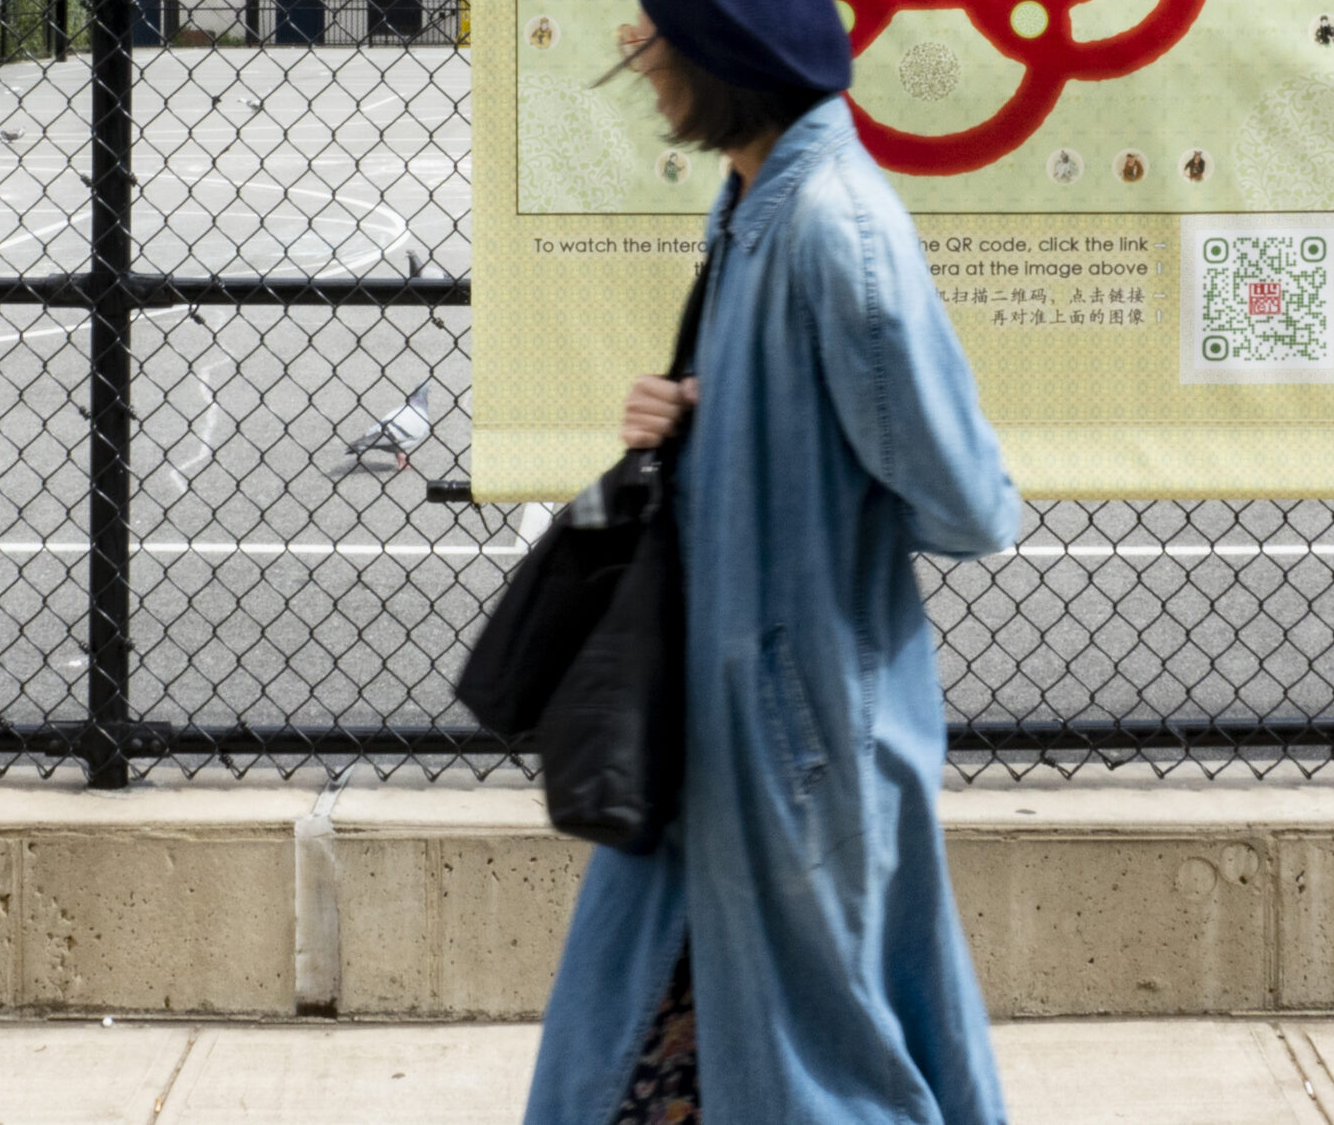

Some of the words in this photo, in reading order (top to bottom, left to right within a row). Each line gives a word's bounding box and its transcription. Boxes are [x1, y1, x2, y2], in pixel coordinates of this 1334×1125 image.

[534, 238, 554, 253] To
[560, 237, 617, 253] watch
[623, 237, 652, 253] the
[919, 239, 940, 252] he
[946, 237, 973, 253] QR
[979, 237, 1032, 253] code,
[1038, 237, 1079, 252] click
[1085, 237, 1114, 252] the
[1119, 237, 1149, 252] link
[930, 264, 960, 276] era
[966, 261, 984, 276] at
[990, 260, 1019, 276] the
[1025, 260, 1082, 278] image
[1088, 260, 1148, 276] above
